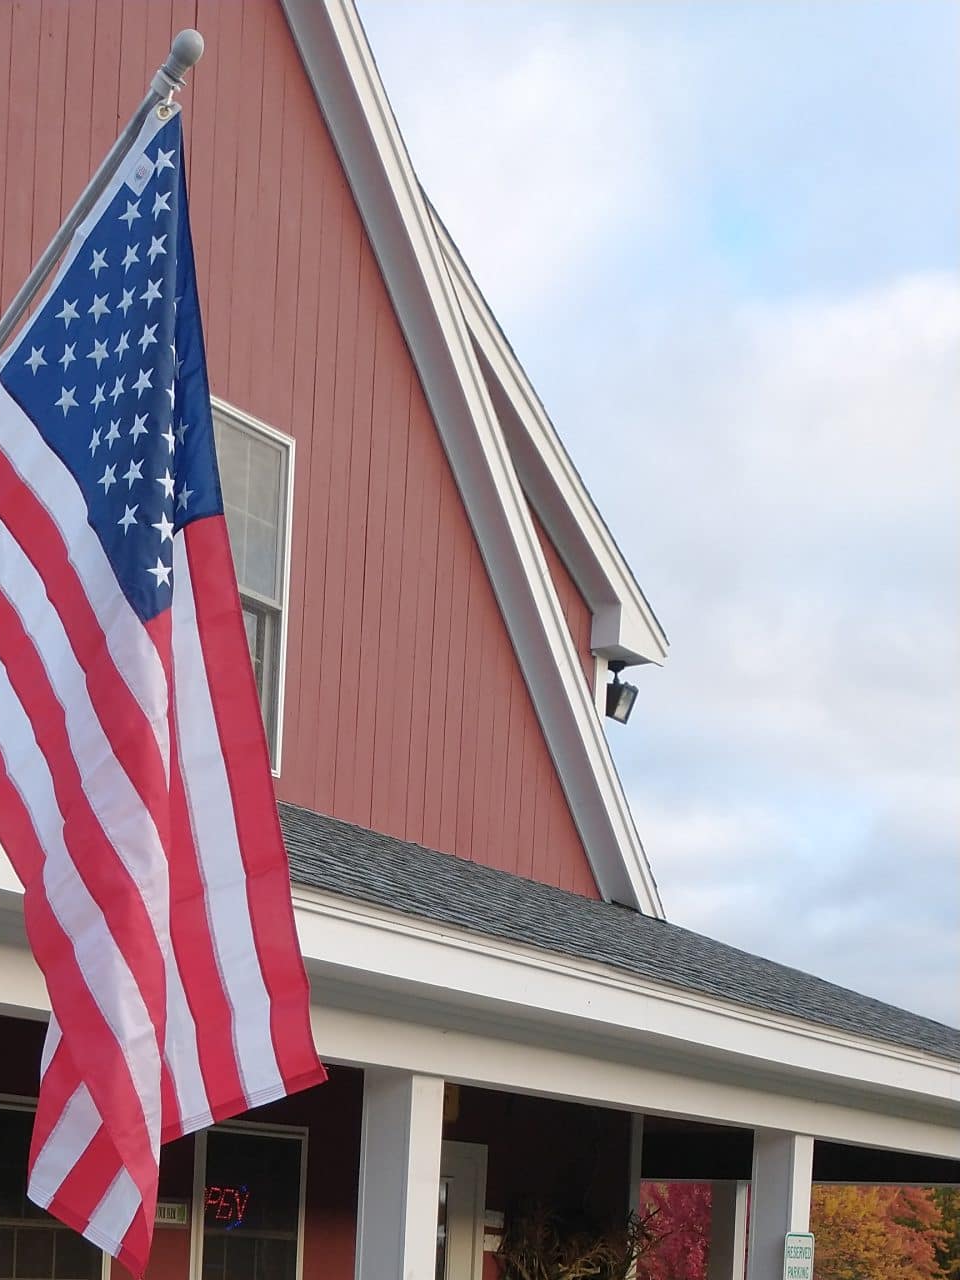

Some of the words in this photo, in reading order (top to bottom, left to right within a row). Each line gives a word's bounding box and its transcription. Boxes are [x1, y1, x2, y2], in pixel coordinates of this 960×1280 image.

[203, 1186, 249, 1222] PEN
[786, 1246, 812, 1260] RESERVED
[787, 1265, 809, 1279] PARKING
